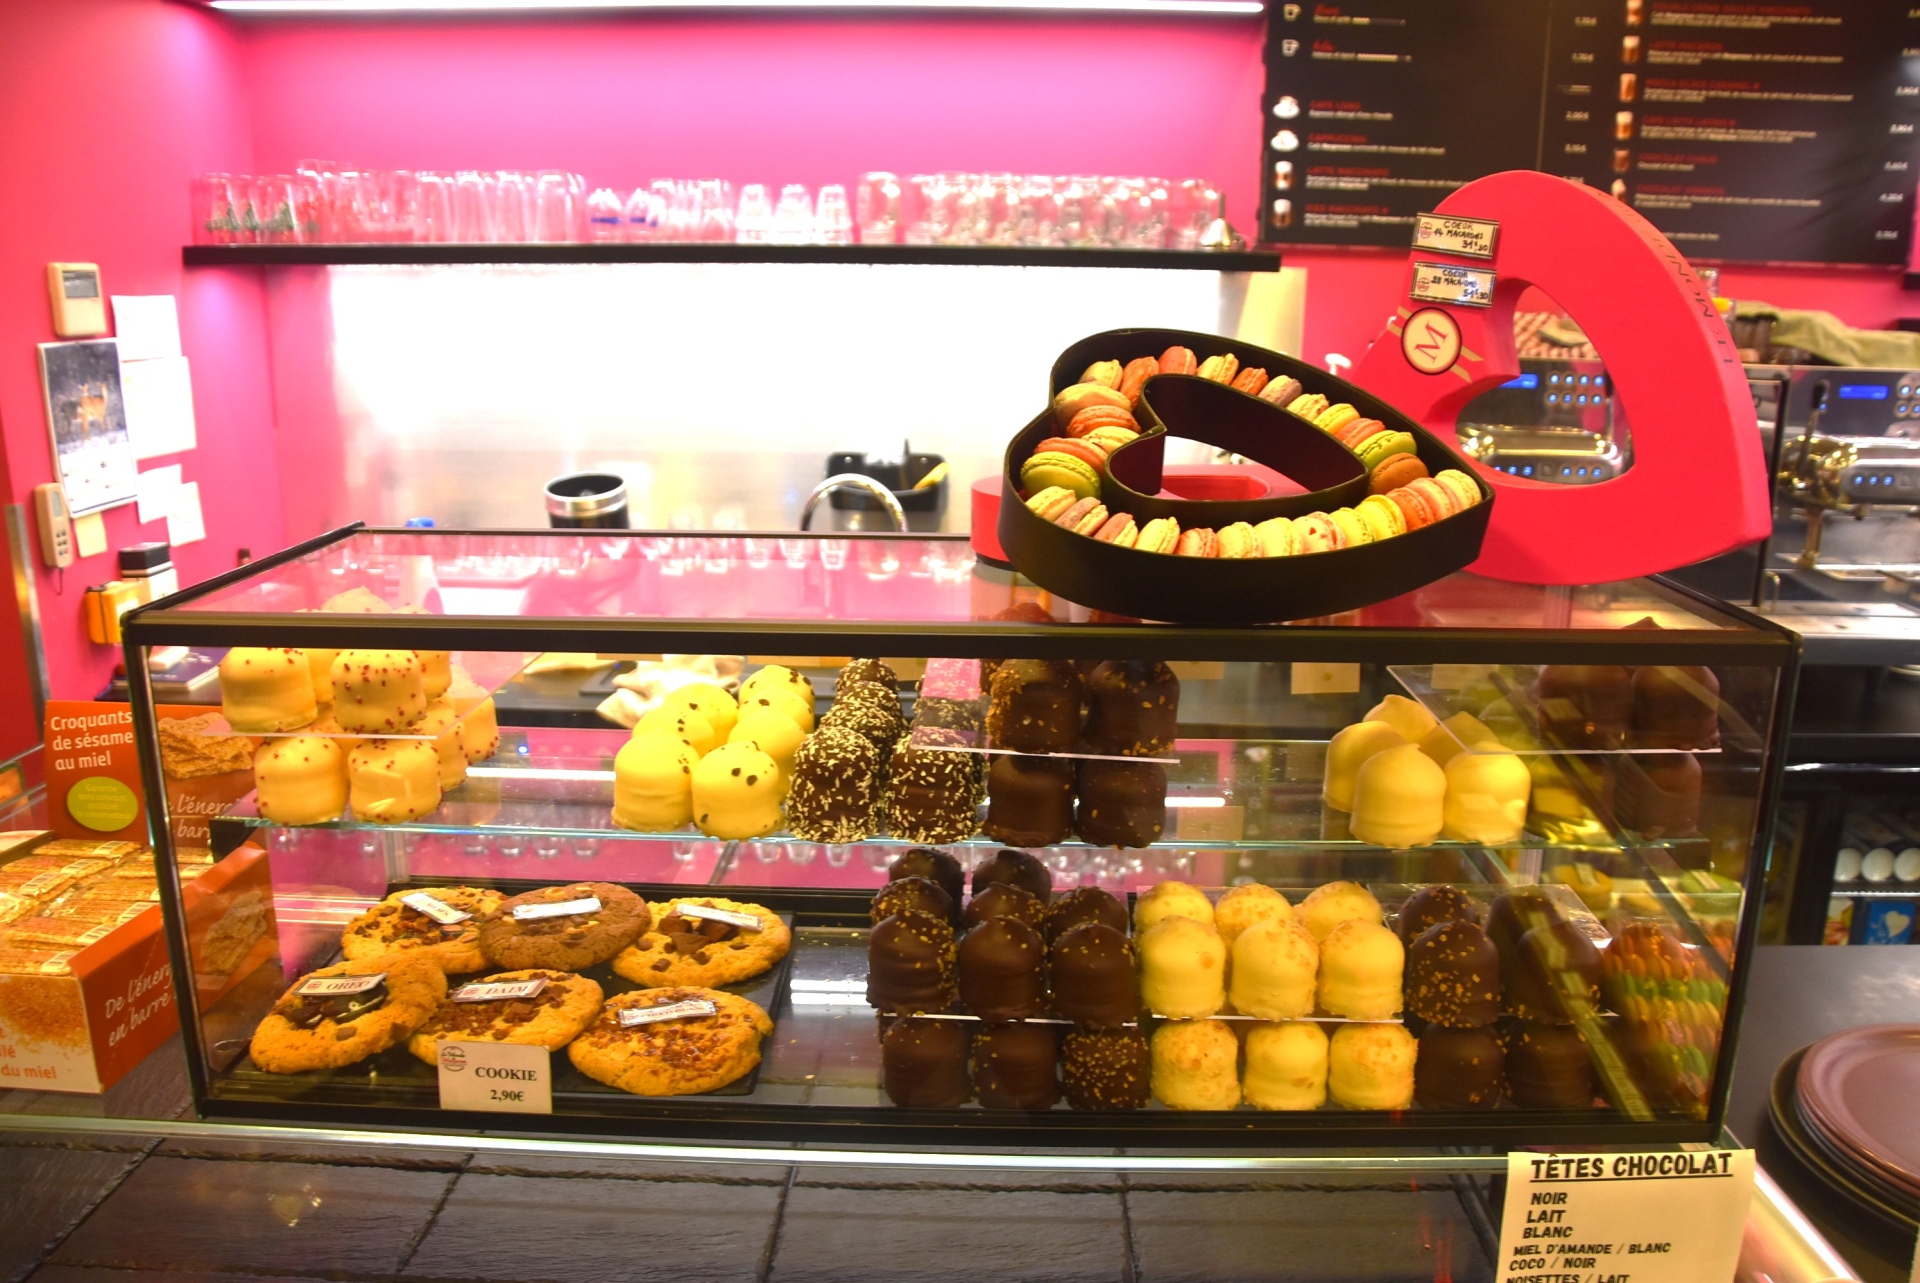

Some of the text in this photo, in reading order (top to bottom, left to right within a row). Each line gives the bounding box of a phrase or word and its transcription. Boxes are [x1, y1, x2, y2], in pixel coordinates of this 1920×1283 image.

[1414, 320, 1449, 363] M
[50, 710, 133, 731] Croquants
[52, 732, 133, 751] de sésame
[55, 750, 112, 771] au miel
[485, 985, 528, 995] DAIM
[105, 996, 126, 1019] De
[108, 992, 172, 1047] en barre
[1, 1063, 57, 1079] du miel
[475, 1066, 538, 1081] COOKIE
[490, 1089, 525, 1102] 2,90€
[1530, 1152, 1732, 1180] TÊTES CHOCOLAT
[1530, 1192, 1568, 1206] NOIR
[1526, 1209, 1566, 1223] LAIT
[1522, 1226, 1573, 1239] BLANC
[1513, 1245, 1542, 1256] MIEL
[1546, 1244, 1613, 1255] D'AMANDE
[1628, 1243, 1671, 1254] BLANC
[1509, 1258, 1546, 1271] COCO
[1563, 1257, 1597, 1269] NOIR
[1597, 1275, 1630, 1283] LAIT
